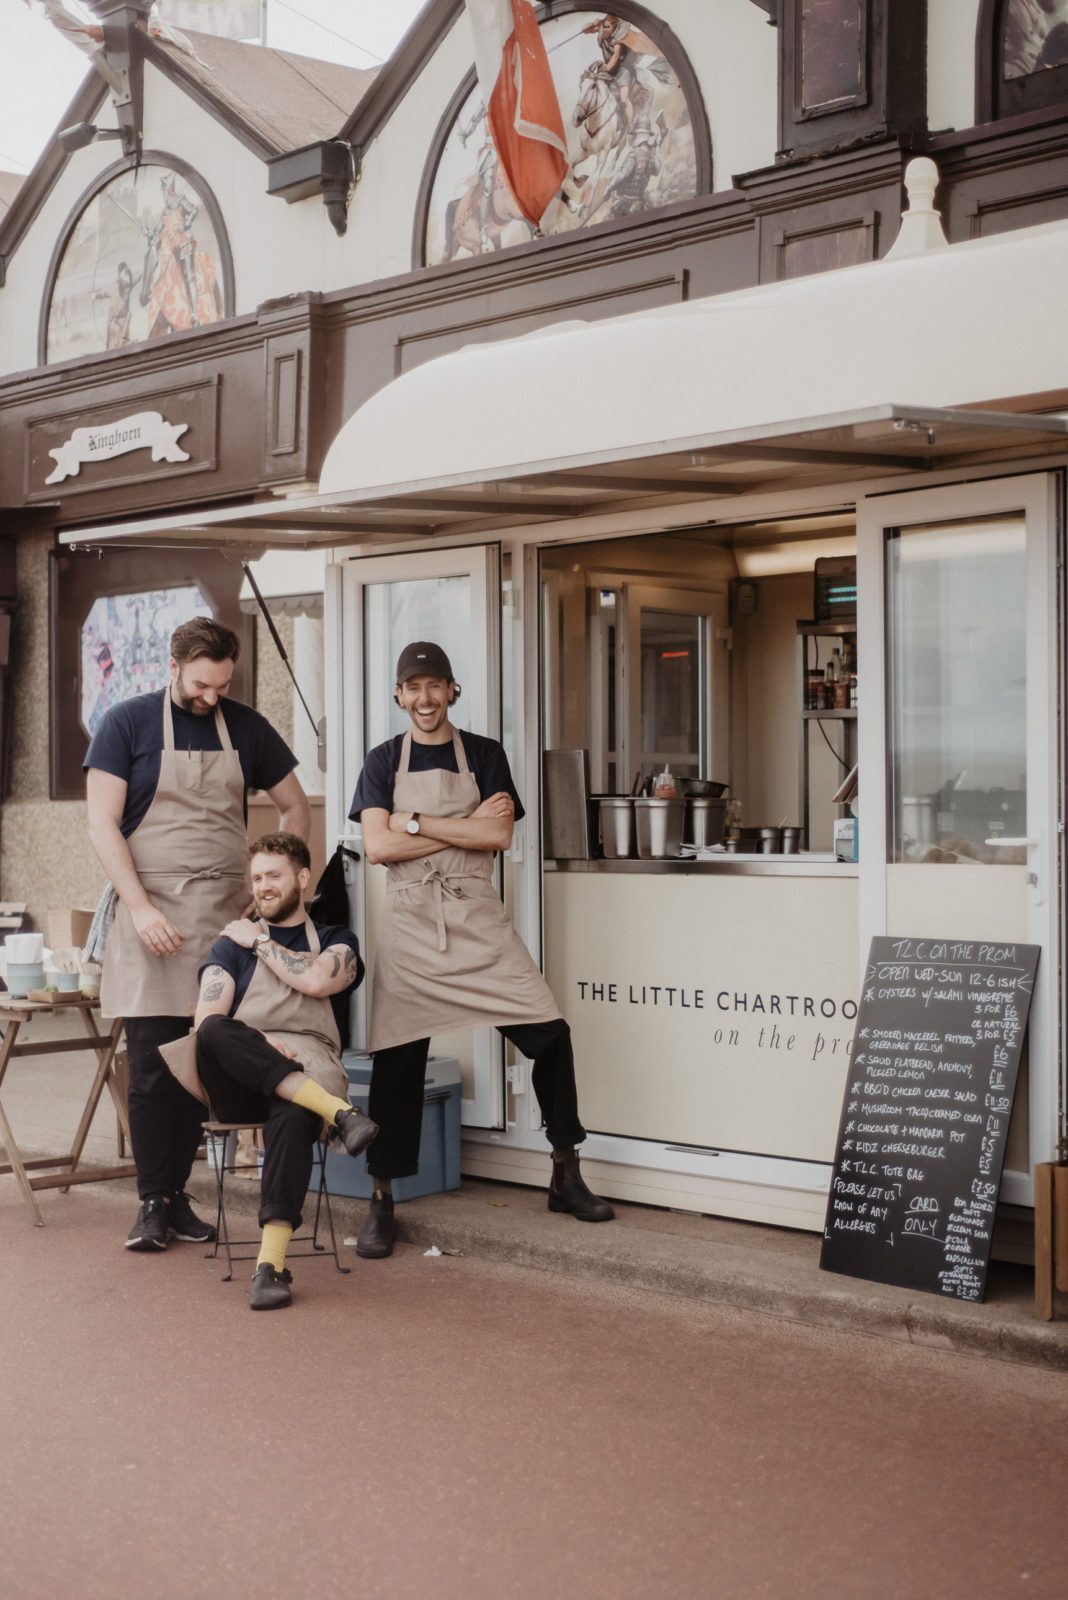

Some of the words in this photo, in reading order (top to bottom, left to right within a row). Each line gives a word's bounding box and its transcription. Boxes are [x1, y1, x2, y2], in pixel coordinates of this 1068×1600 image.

[88, 427, 142, 450] Kinghorn
[930, 944, 947, 958] ON
[950, 946, 973, 960] THE
[978, 946, 1015, 962] PROM
[878, 967, 909, 980] OPEN
[578, 982, 617, 1002] THE
[629, 985, 704, 1009] LITTLE
[878, 988, 916, 999] OYSTERS
[974, 1005, 982, 1013] 3
[984, 1004, 1000, 1013] FOR
[1004, 1004, 1018, 1018] £6
[972, 1020, 982, 1028] OR
[984, 1020, 1021, 1030] NATURAL
[714, 1029, 740, 1045] on
[758, 1025, 796, 1050] the
[872, 1029, 901, 1040] SMOKED
[904, 1032, 940, 1040] MACKEREL
[976, 1030, 983, 1039] 3
[984, 1030, 1000, 1039] FOR
[1004, 1030, 1018, 1041] £5
[915, 1042, 943, 1053] RELISH
[994, 1045, 1008, 1060] £6
[867, 1055, 891, 1066] SQUID
[866, 1067, 896, 1077] PICKLED
[898, 1070, 925, 1080] LEMON
[892, 1087, 921, 1097] CHICKEN
[954, 1092, 976, 1102] SALAD
[861, 1103, 902, 1115] MUSHROOM
[964, 1114, 982, 1123] CORN
[857, 1123, 899, 1134] CHOCOLATE
[950, 1131, 966, 1142] POT
[856, 1141, 878, 1153] KIDZ
[881, 1143, 946, 1158] CHEESEBURGER
[982, 1137, 996, 1152] £5
[979, 1155, 993, 1169] £5
[882, 1166, 903, 1177] TOTE
[907, 1168, 924, 1181] BAG
[837, 1181, 866, 1194] PLEASE
[867, 1186, 882, 1199] LET
[884, 1191, 895, 1200] US
[834, 1199, 853, 1211] KNOW
[858, 1203, 867, 1214] OF
[871, 1205, 888, 1220] ANY
[909, 1196, 939, 1210] CARD
[834, 1219, 876, 1234] ALLERGIES
[904, 1219, 937, 1235] ONLY
